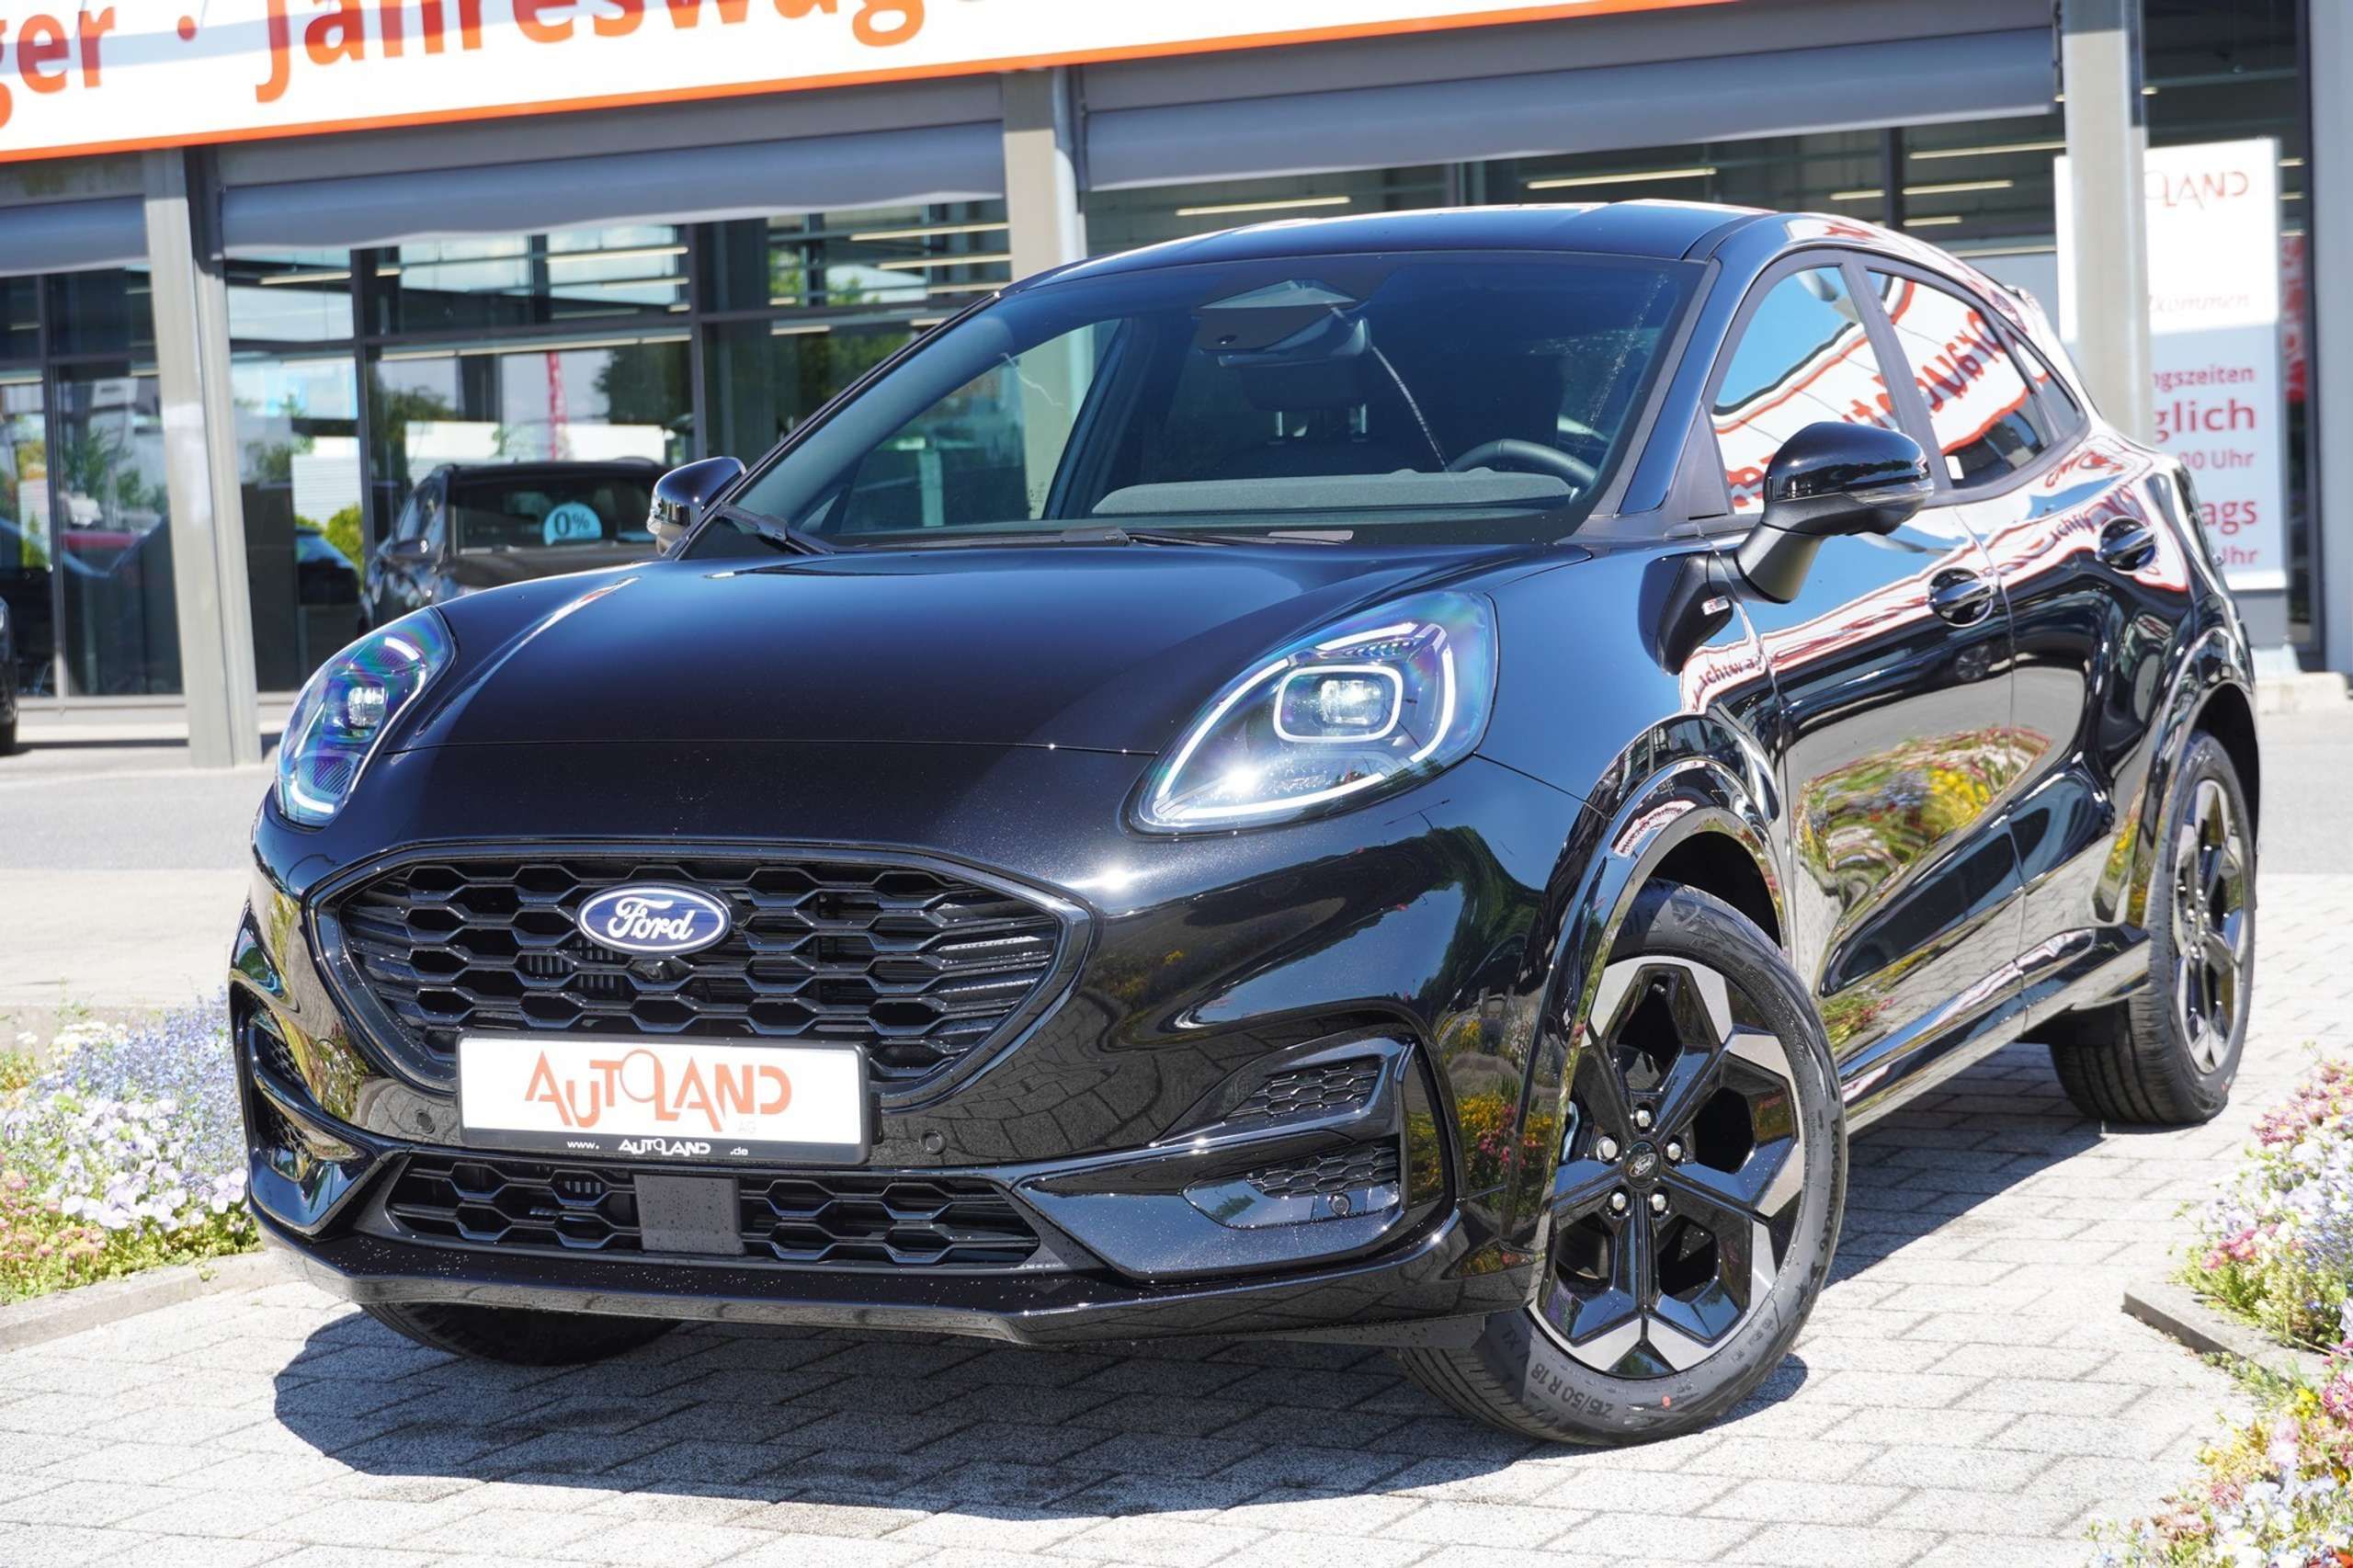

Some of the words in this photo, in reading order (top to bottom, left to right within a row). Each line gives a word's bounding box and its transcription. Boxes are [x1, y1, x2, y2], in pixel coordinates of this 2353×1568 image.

[2211, 449, 2255, 470] Uhr
[608, 896, 695, 940] Ford
[524, 1049, 792, 1132] AUTOLAND
[618, 1138, 711, 1156] AUTOLAND
